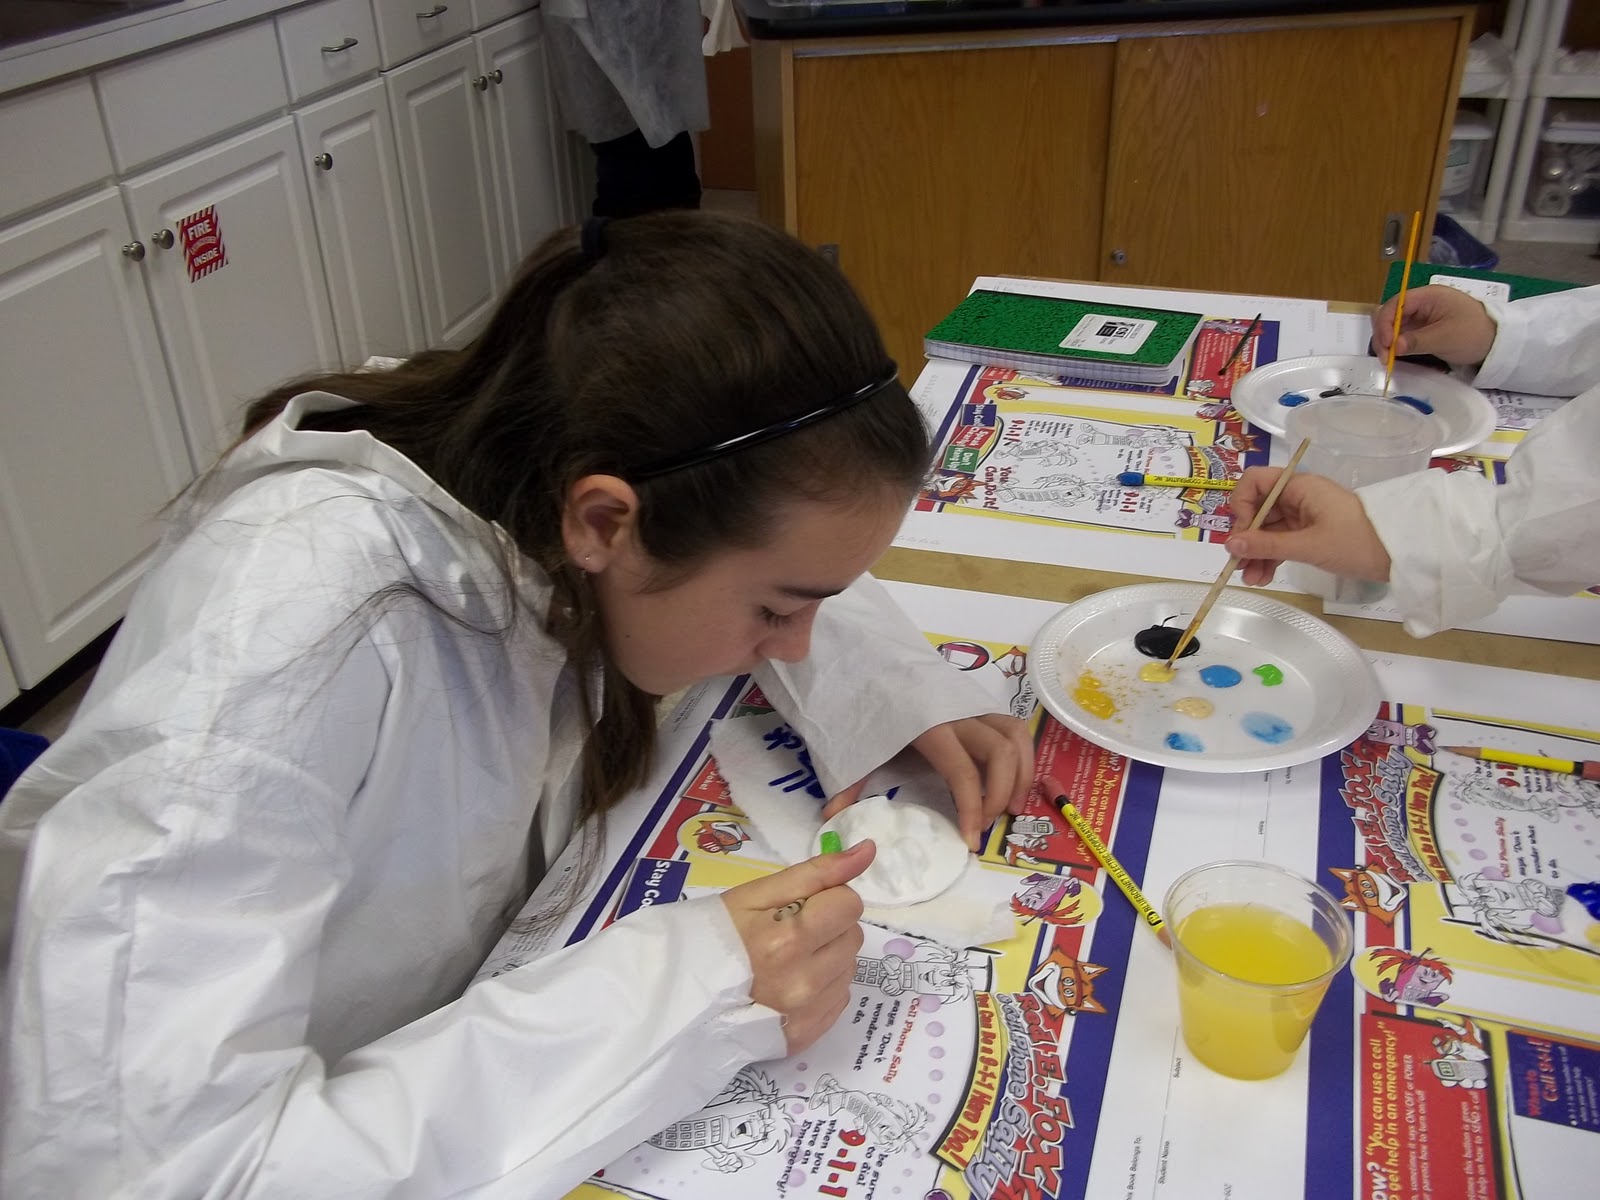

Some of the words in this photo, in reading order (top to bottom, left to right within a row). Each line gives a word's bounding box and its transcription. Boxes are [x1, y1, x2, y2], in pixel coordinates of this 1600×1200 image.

[187, 219, 212, 241] FIRE
[193, 247, 220, 267] INSIDE
[985, 466, 998, 482] Can
[1000, 466, 1012, 482] You
[985, 485, 997, 496] Do
[982, 496, 999, 510] It!
[1094, 771, 1104, 787] help
[1089, 795, 1098, 807] an
[1092, 787, 1102, 795] in
[1099, 794, 1109, 810] can
[1095, 811, 1105, 826] use
[1076, 820, 1104, 853] COOPERATIVE
[645, 860, 671, 886] Stay
[1102, 853, 1124, 878] ELECTRIC
[859, 996, 869, 1008] to
[907, 998, 920, 1018] Cell
[976, 993, 990, 1008] You
[852, 1009, 865, 1025] do,
[865, 1002, 883, 1042] wonder
[885, 999, 900, 1027] says,
[979, 1009, 995, 1029] Can
[1013, 992, 1058, 1044] Red
[895, 1020, 914, 1053] Phone
[853, 1043, 869, 1071] what
[1369, 1039, 1383, 1060] cell
[882, 1055, 901, 1083] Sally
[974, 1055, 999, 1090] 9-1-1
[1007, 1031, 1031, 1100] Phone
[1173, 1057, 1182, 1078] Subject
[1372, 1062, 1382, 1070] a
[1403, 1055, 1415, 1080] POWER
[1372, 1072, 1383, 1094] use
[1539, 1075, 1558, 1101] Call
[962, 1089, 992, 1123] Hero
[1372, 1097, 1384, 1120] can
[1527, 1081, 1540, 1116] When
[1387, 1102, 1399, 1119] an
[807, 1119, 826, 1147] have
[820, 1119, 838, 1149] when
[1385, 1121, 1399, 1135] in
[1408, 1124, 1417, 1141] says
[1418, 1115, 1427, 1132] turn
[940, 1122, 979, 1169] Too!
[965, 1097, 1031, 1200] Sally
[1419, 1133, 1427, 1143] to
[1462, 1132, 1473, 1158] button
[801, 1149, 811, 1165] an
[865, 1146, 876, 1159] to
[875, 1153, 888, 1167] be
[1129, 1145, 1141, 1172] Belongs
[1161, 1140, 1170, 1159] Name
[1385, 1137, 1400, 1167] help
[1419, 1144, 1428, 1161] how
[811, 1152, 824, 1174] you
[817, 1128, 866, 1198] 9-1-1
[1158, 1160, 1167, 1185] Student
[1409, 1150, 1418, 1192] sometimes
[856, 1162, 871, 1187] dial
[865, 1170, 879, 1200] sure
[1126, 1173, 1136, 1190] Book
[1385, 1169, 1401, 1191] get
[1420, 1162, 1431, 1191] parents
[1476, 1177, 1488, 1195] help
